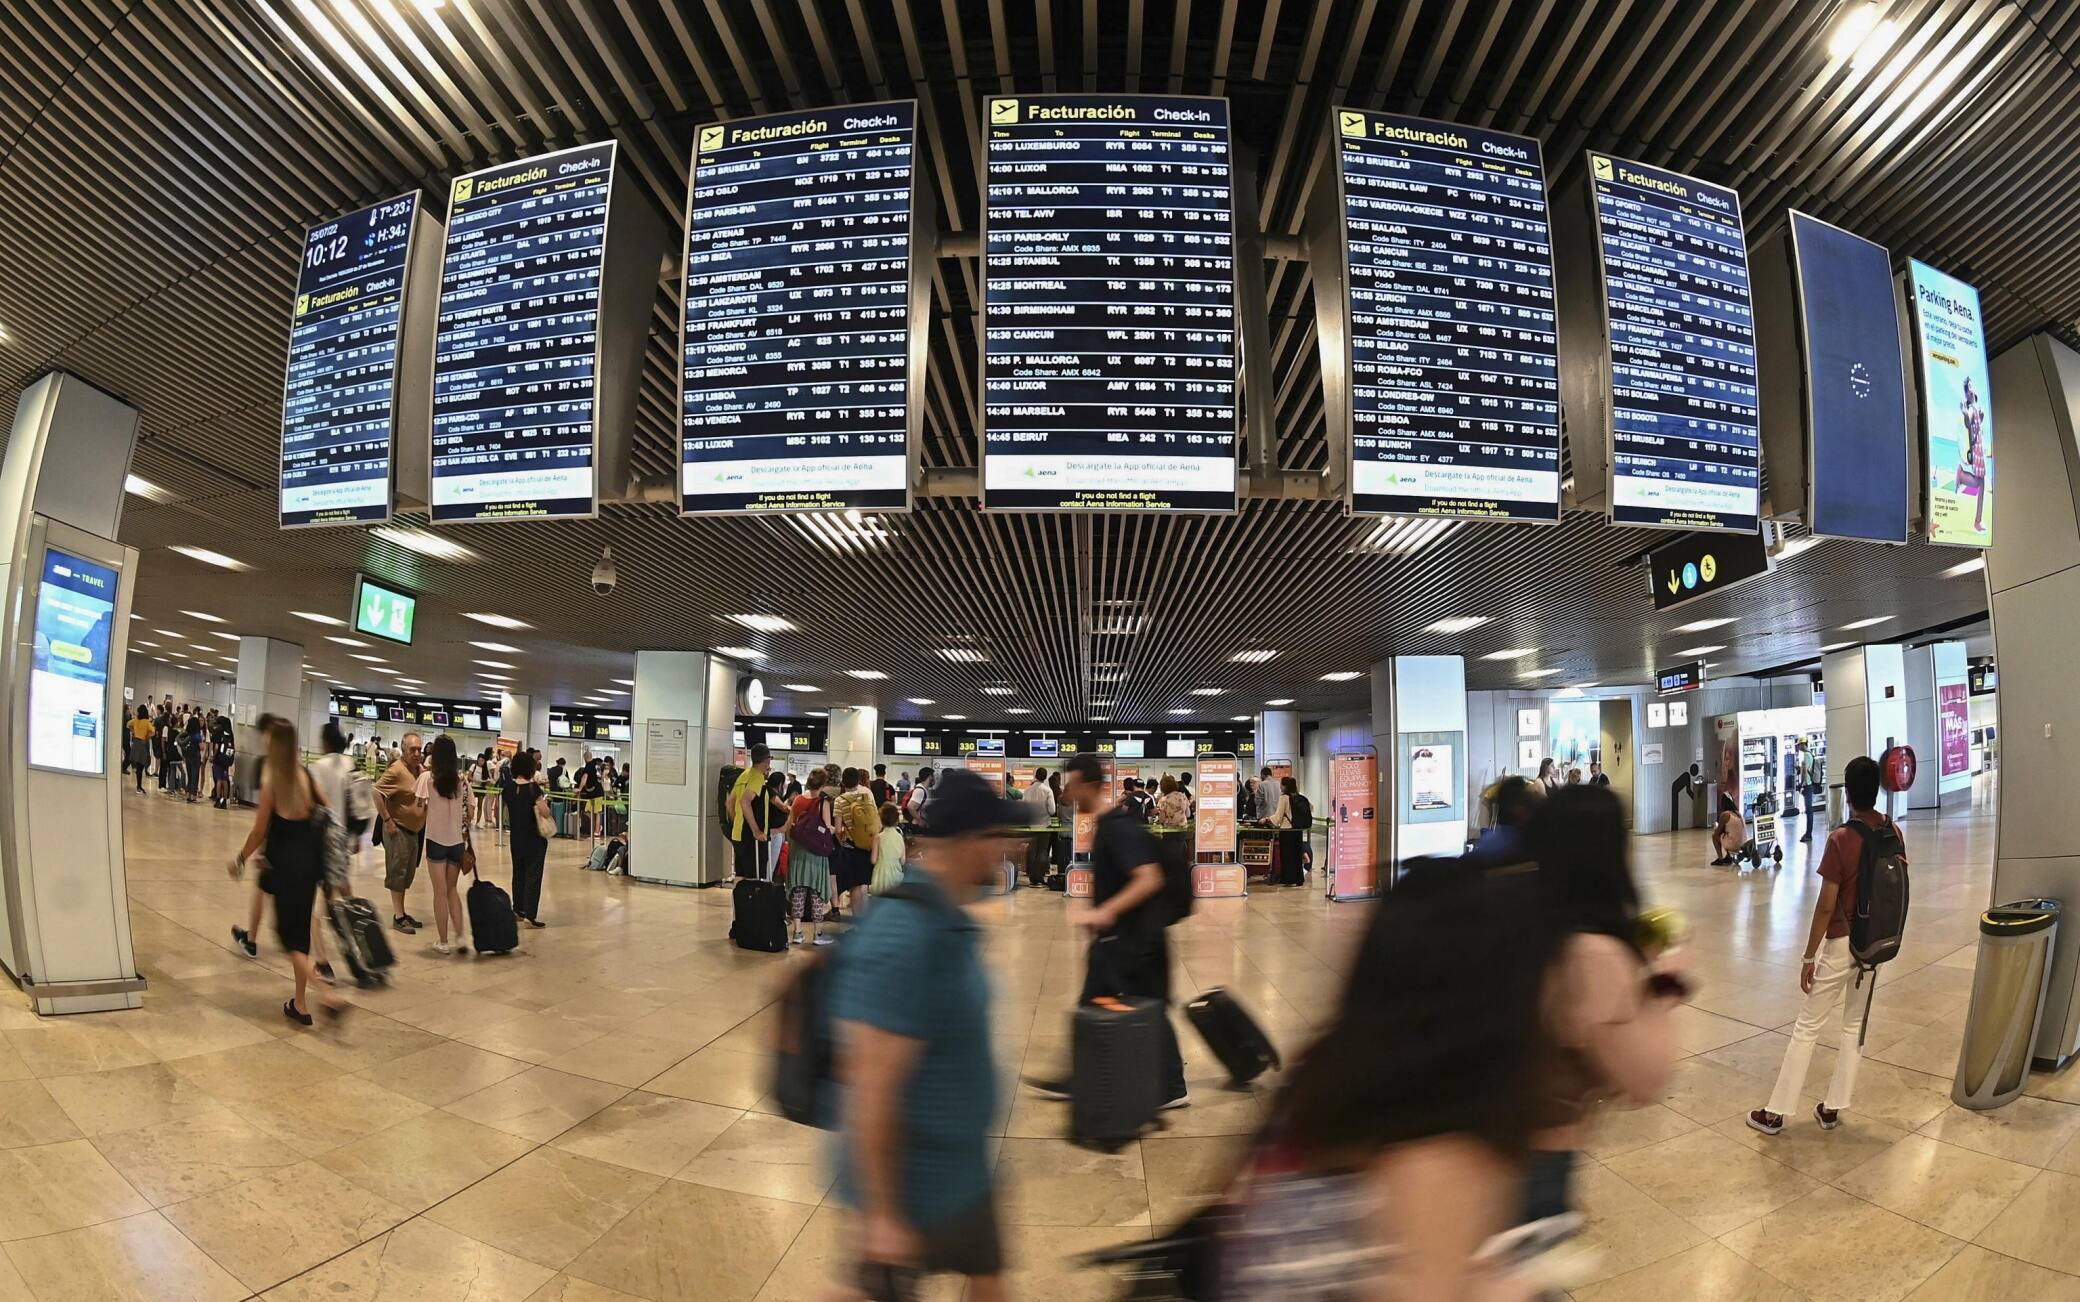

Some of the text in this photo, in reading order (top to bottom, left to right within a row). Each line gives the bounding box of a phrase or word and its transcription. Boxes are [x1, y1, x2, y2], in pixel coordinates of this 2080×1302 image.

[1029, 105, 1210, 122] Facturación Check-in
[732, 115, 897, 144] Facturación Check-in
[1120, 130, 1140, 138] Flight
[1151, 130, 1181, 138] Terminal
[1375, 122, 1527, 159] Facturación Check-in
[1015, 142, 1080, 150] LUXEMBURGO
[1106, 142, 1125, 150] RYR
[1015, 164, 1047, 172] LUXOR
[1161, 165, 1171, 173] T1
[1183, 166, 1198, 174] 332
[1212, 167, 1227, 175] 333
[477, 158, 600, 193] Facturación Check-in
[716, 186, 738, 195] OSLO
[989, 187, 1012, 195] 14:10
[1015, 187, 1022, 195] P.
[1107, 187, 1126, 195] RYR
[1162, 187, 1172, 195] T1
[1619, 168, 1729, 210] Facturación Check-in
[989, 210, 1011, 218] 14:10
[1107, 210, 1122, 218] ISR
[1163, 211, 1172, 219] T1
[1214, 213, 1229, 221] 122
[310, 224, 338, 242] 25/07/22
[1371, 223, 1407, 234] MALAGA
[712, 229, 744, 240] ATENAS
[988, 233, 1174, 242] 14:10 PARIS-ORLY UX T2
[306, 236, 348, 269] 10:12
[1014, 257, 1060, 265] ISTANBUL
[1107, 257, 1120, 265] TK
[1163, 258, 1173, 266] T1
[1215, 260, 1230, 269] 312
[1374, 269, 1395, 278] VIGO
[1014, 281, 1066, 290] MONTREAL
[1164, 282, 1174, 290] T1
[1216, 284, 1231, 293] 173
[1416, 285, 1430, 294] DAL
[311, 277, 395, 308] Facturación Check-in
[1919, 284, 1952, 315] Parking
[987, 306, 1174, 316] 14:30 BIRMINGHAM RYR T1
[708, 318, 757, 331] FRANKFURT
[788, 315, 800, 323] LH
[987, 331, 1175, 340] 14:30 CANCUN WFL T1
[707, 343, 746, 353] TORONTO
[1013, 356, 1022, 364] P.
[1026, 355, 1079, 364] MALLORCA
[1107, 356, 1121, 364] UX
[1164, 357, 1176, 366] T2
[706, 367, 748, 377] MENORCA
[1378, 366, 1423, 376] ROMA-FCO
[1014, 382, 1046, 390] LUXOR
[1107, 382, 1129, 390] AMV
[1164, 383, 1175, 391] T1
[1217, 385, 1232, 393] 321
[987, 407, 1175, 416] 14:40 MARSELLA RYR T1
[706, 416, 741, 425] VENECIA
[1378, 415, 1409, 425] LISBOA
[705, 440, 733, 449] LUXOR
[889, 434, 904, 443] 132
[987, 433, 1010, 442] 14:45
[1013, 433, 1048, 441] BEIRUT
[1164, 434, 1175, 443] T1
[1378, 440, 1411, 450] MUNICH
[1420, 454, 1429, 462] EY
[1472, 473, 1485, 482] App
[1487, 474, 1505, 482] oficial
[1140, 492, 1155, 500] flight
[82, 574, 104, 588] TRAVEL
[794, 737, 808, 745] 333
[925, 742, 939, 750] 331
[959, 742, 974, 751] 330
[1061, 743, 1076, 752] 329
[1097, 744, 1114, 752] 328
[1197, 743, 1212, 752] 327
[1239, 742, 1254, 751] 326
